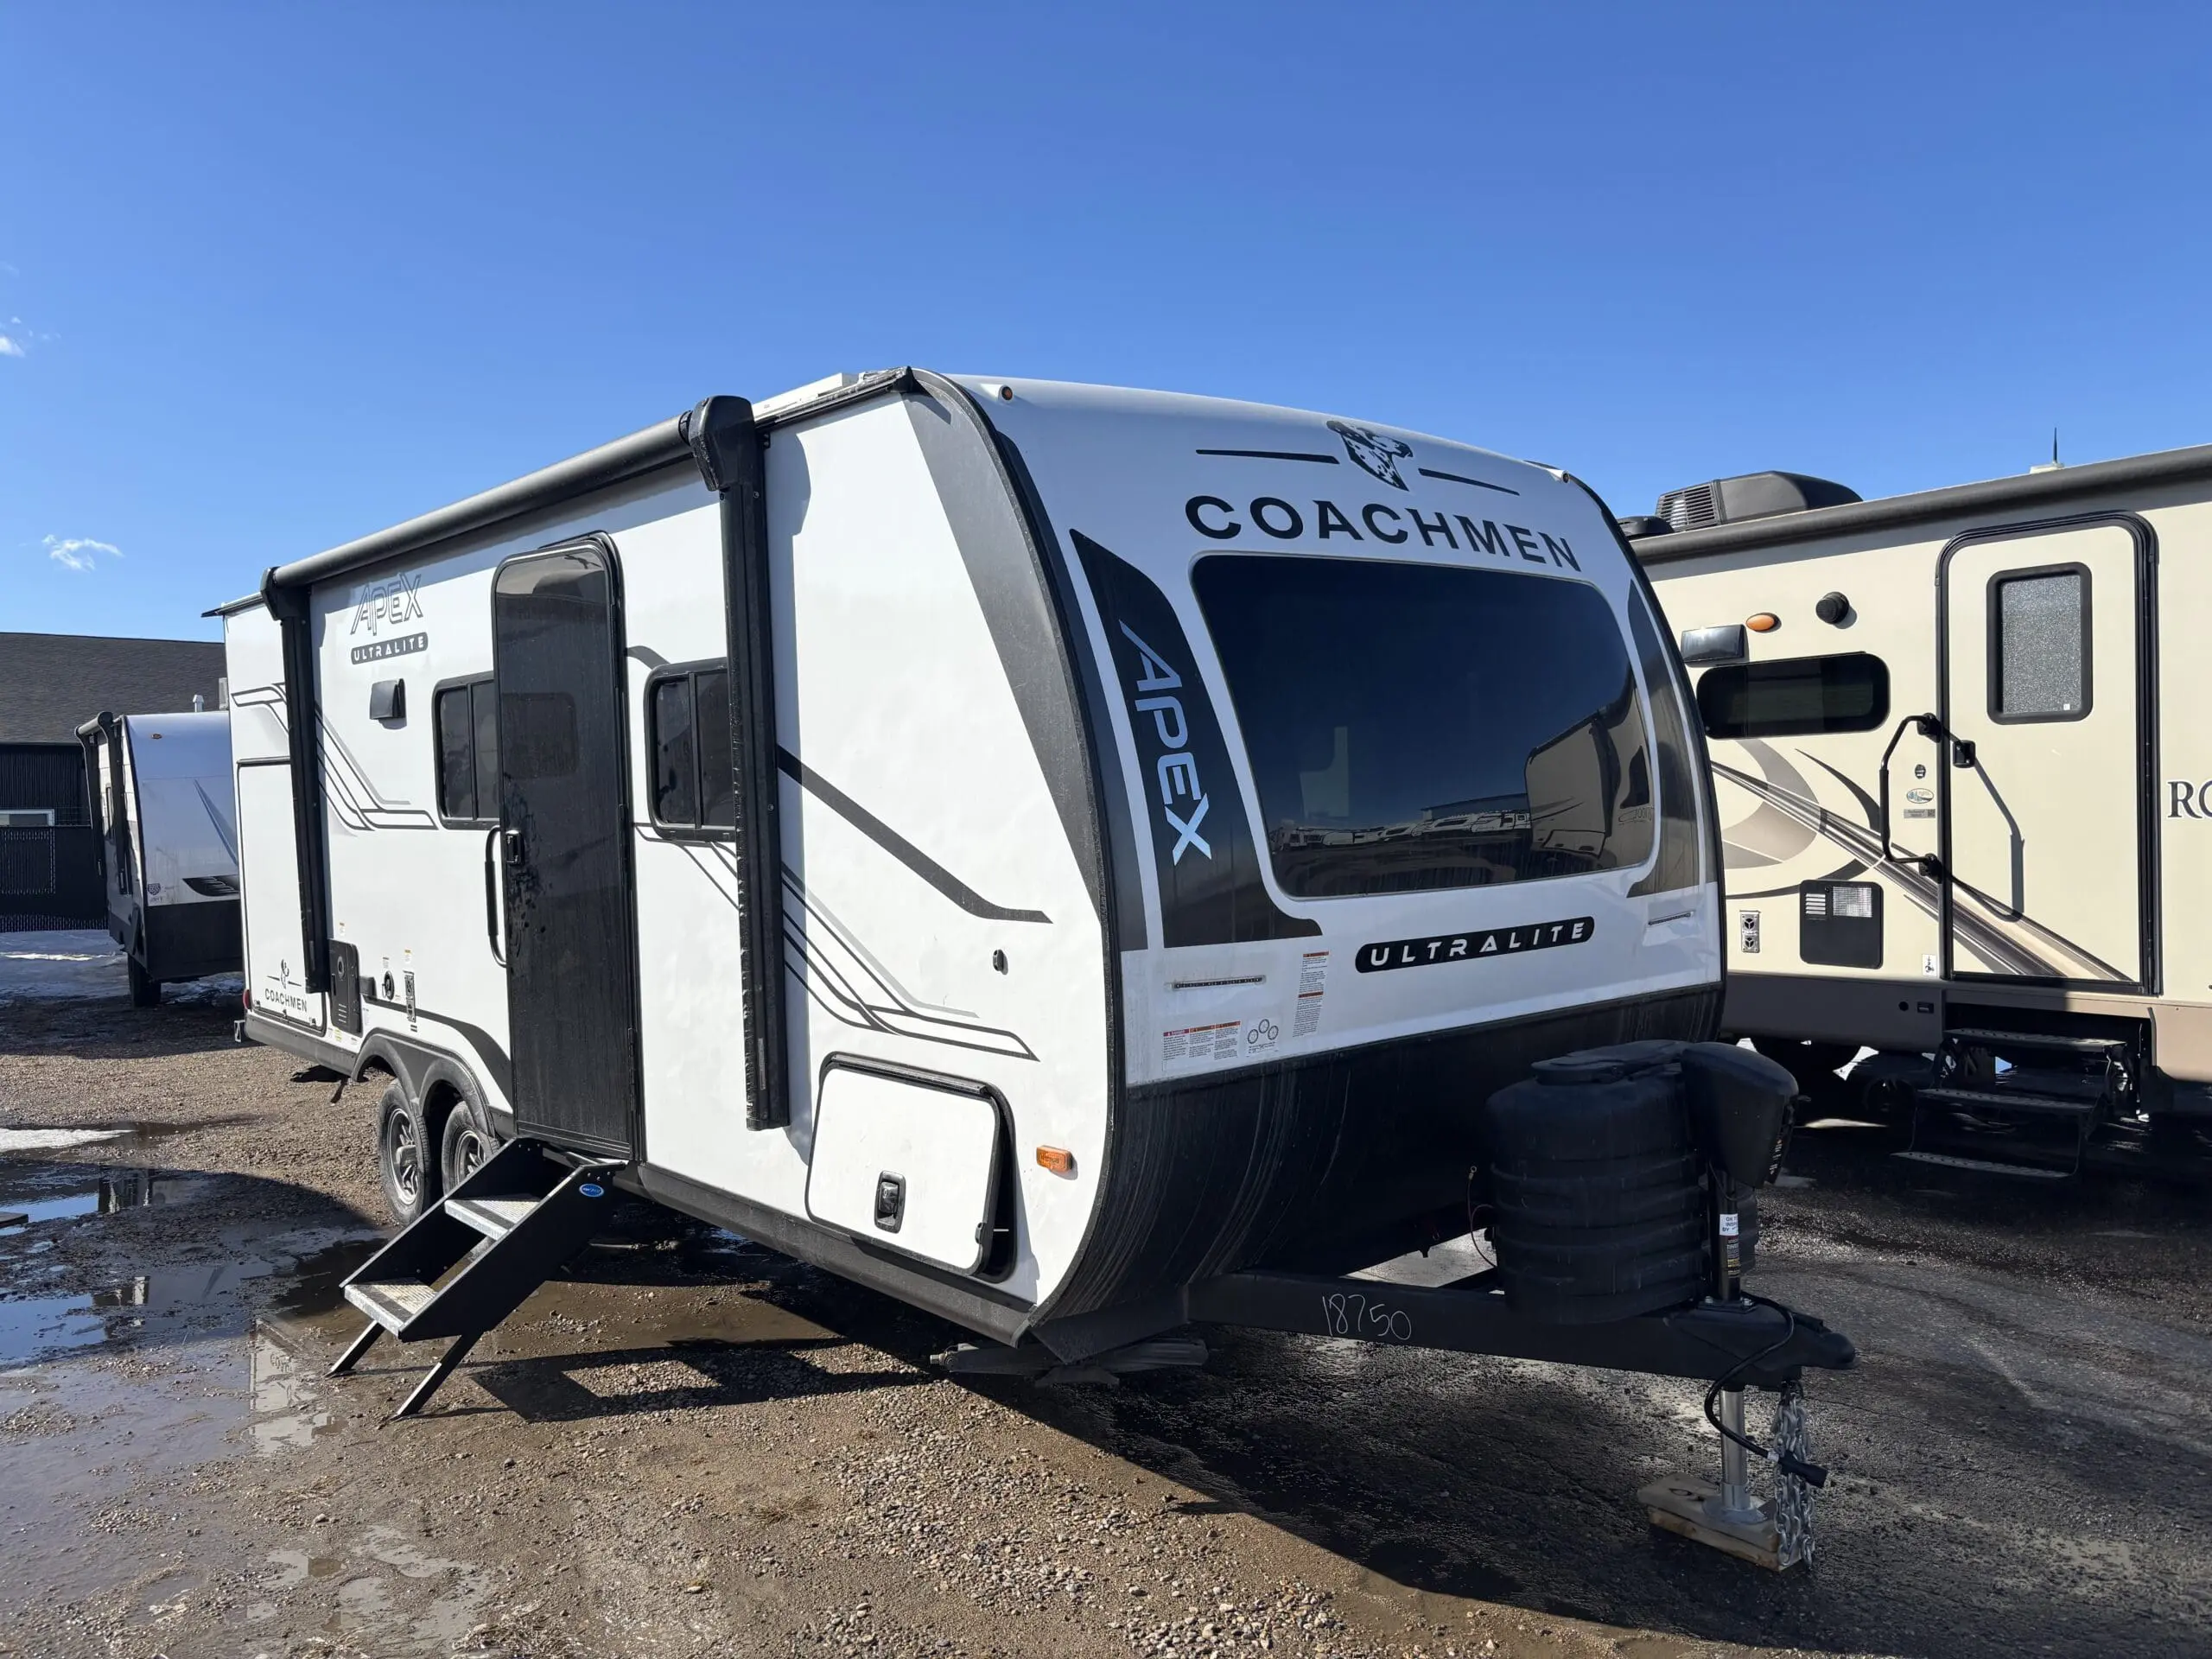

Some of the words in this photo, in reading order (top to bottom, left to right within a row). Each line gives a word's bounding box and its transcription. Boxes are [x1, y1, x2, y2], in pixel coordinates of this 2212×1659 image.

[1185, 495, 1582, 572] COACHMEN
[350, 573, 423, 636] APEX
[353, 636, 424, 661] ULTRALITE
[1119, 619, 1212, 866] APEX
[1370, 922, 1586, 966] ULTRALITE
[264, 988, 307, 1012] COACHMEN
[1322, 1294, 1412, 1340] 18750
